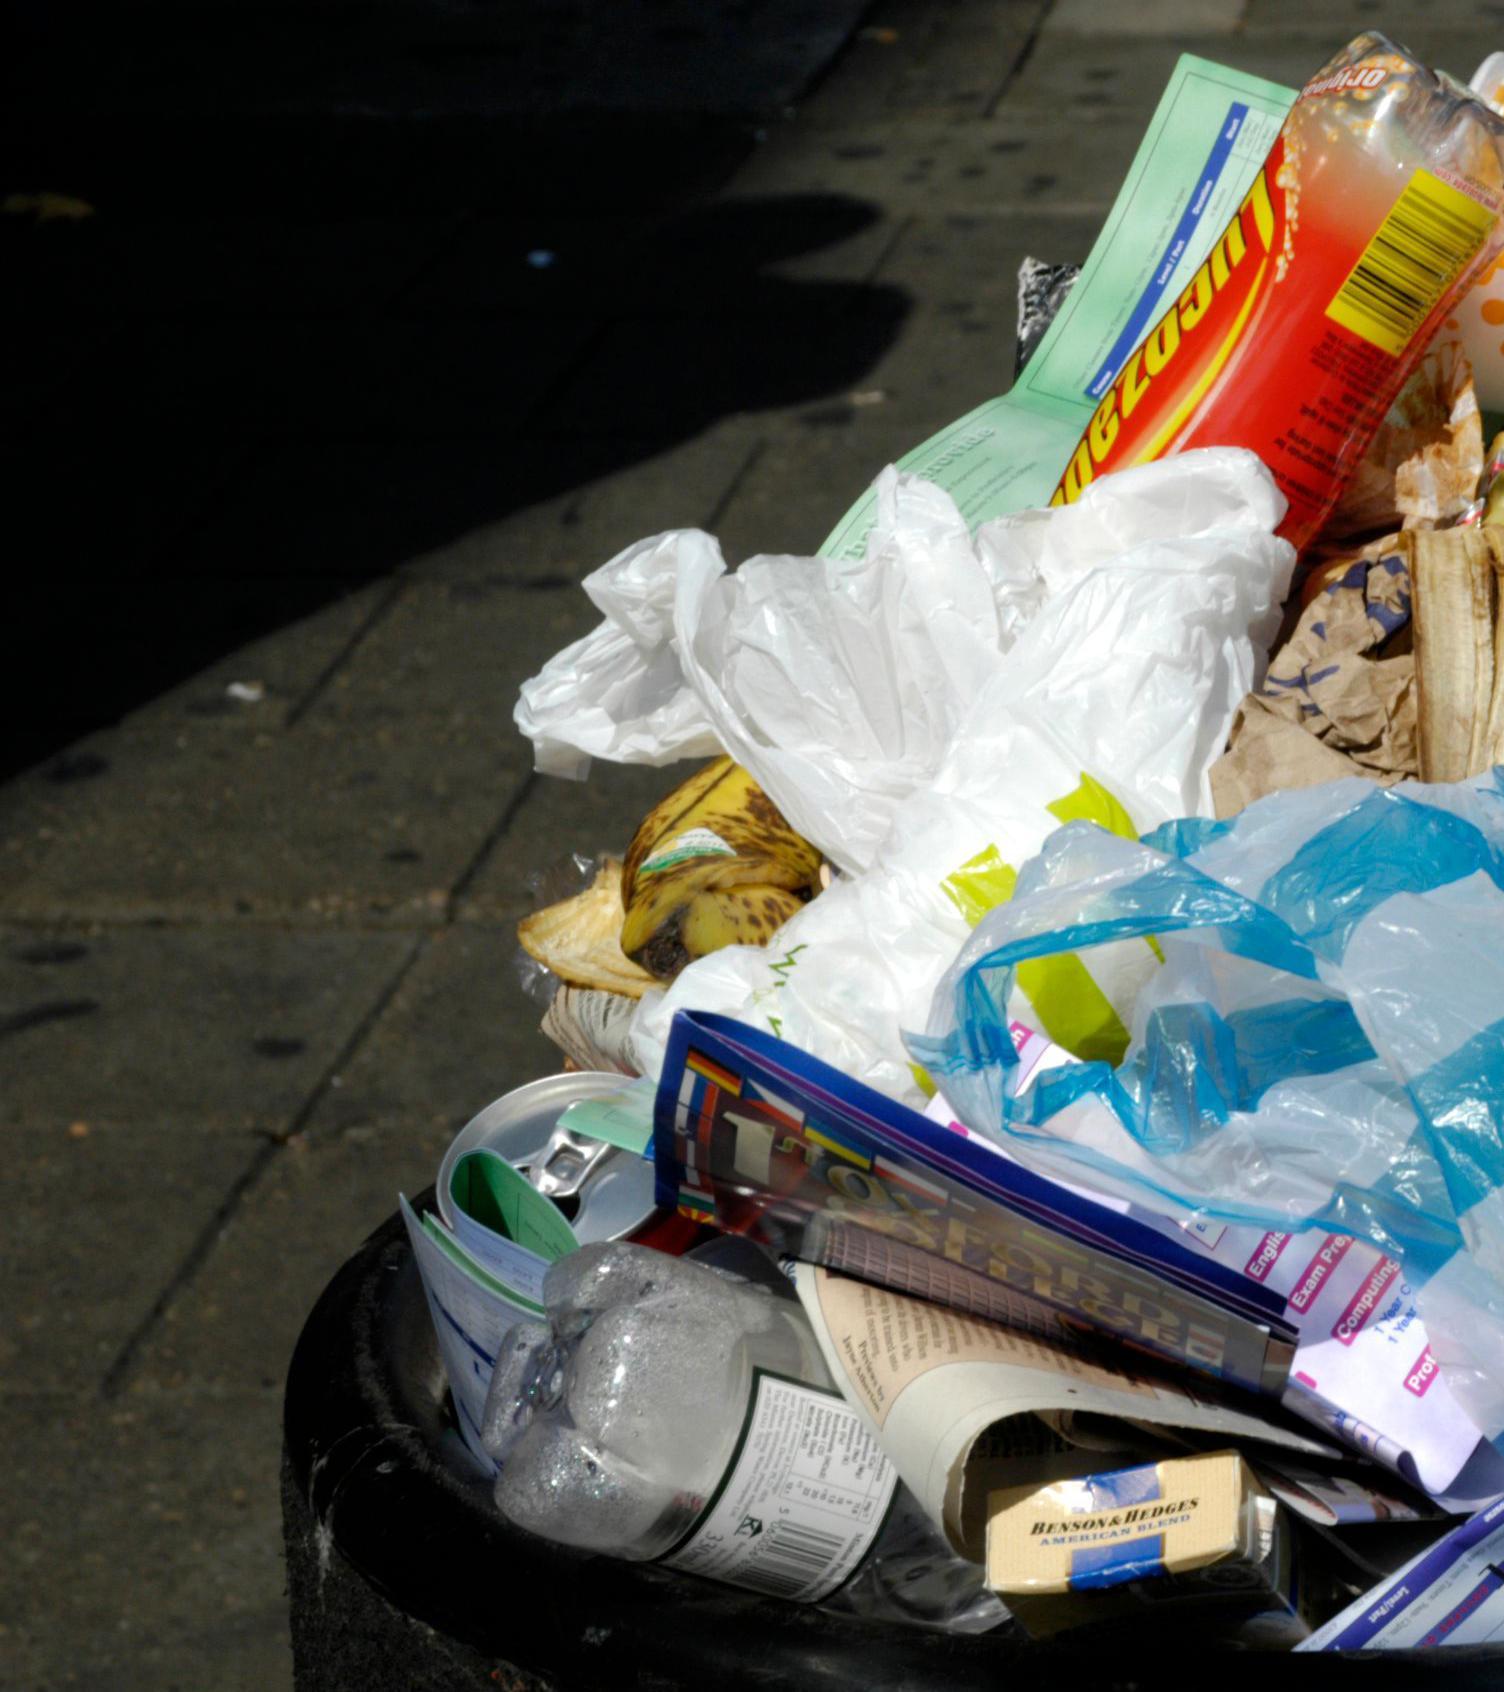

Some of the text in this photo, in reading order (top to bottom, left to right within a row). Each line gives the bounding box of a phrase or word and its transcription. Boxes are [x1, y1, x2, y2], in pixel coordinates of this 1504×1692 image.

[1249, 1230, 1287, 1277] Englis
[1290, 1264, 1327, 1310] Exam
[1336, 1257, 1401, 1340] Computing
[1380, 1296, 1403, 1324] Year
[1393, 1307, 1417, 1334] Year
[1040, 1514, 1191, 1546] AMERICAN BLEND
[1365, 1584, 1411, 1624] Level/Part
